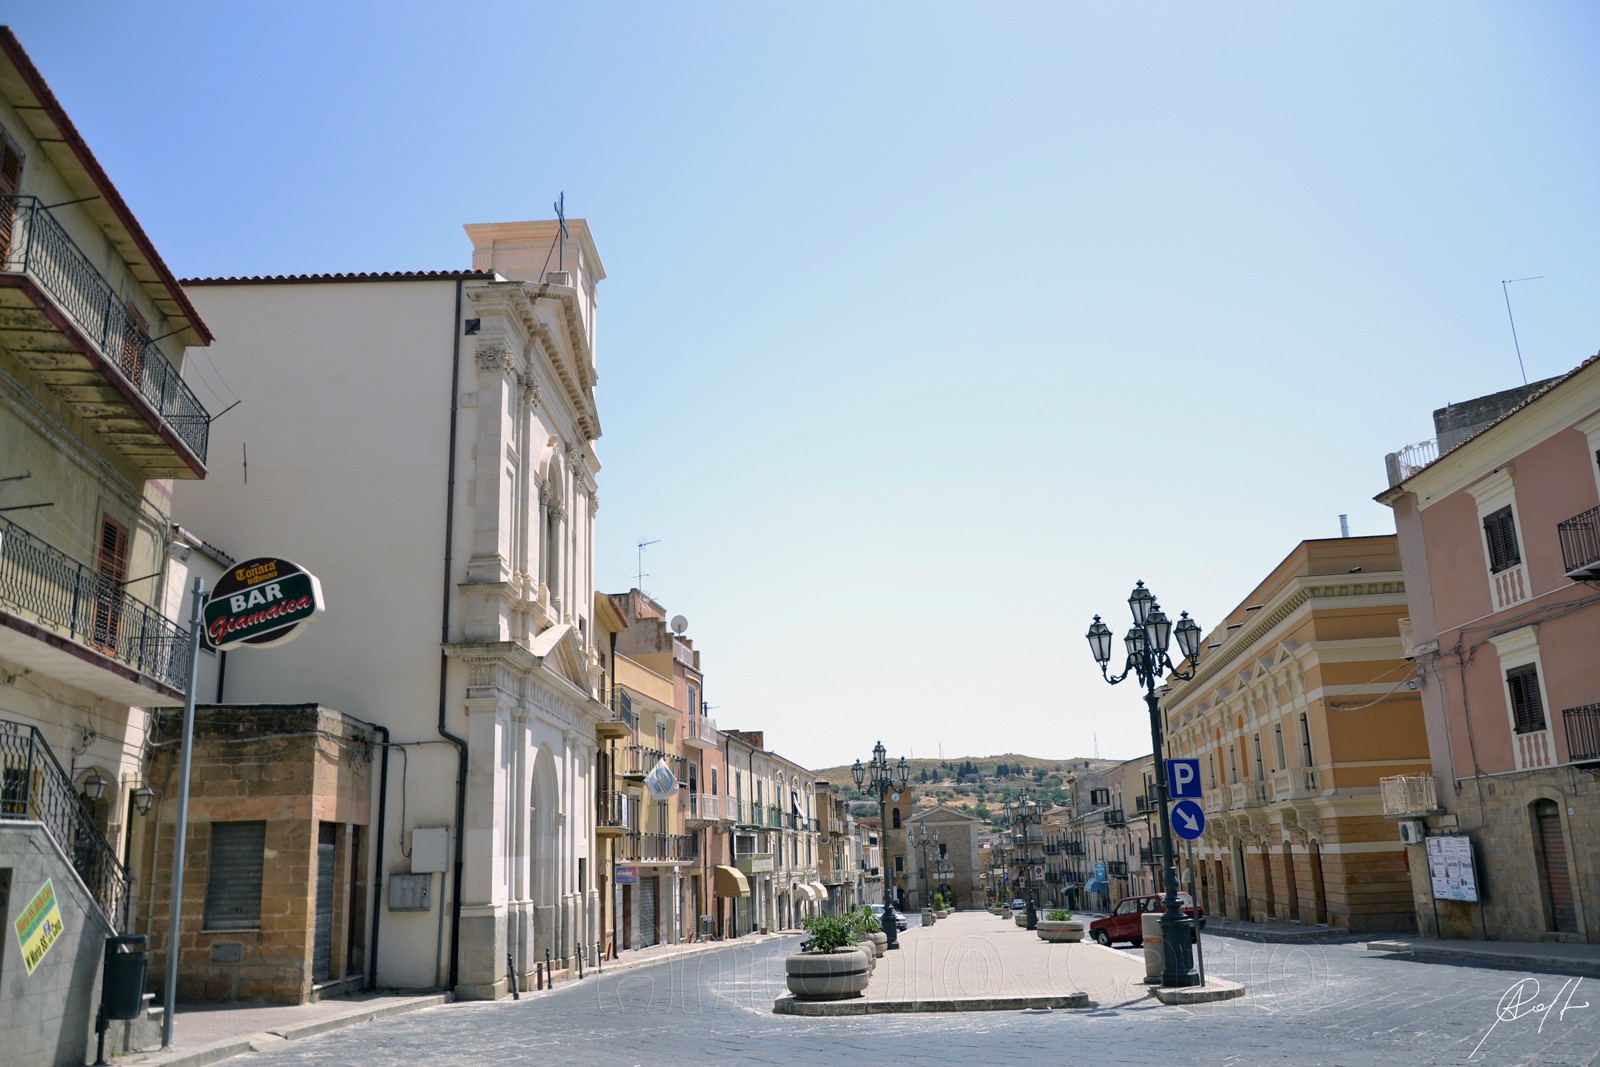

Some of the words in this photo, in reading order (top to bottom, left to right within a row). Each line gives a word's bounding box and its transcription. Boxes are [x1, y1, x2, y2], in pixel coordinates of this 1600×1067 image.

[235, 561, 276, 581] Tonaca
[230, 583, 284, 613] BAR
[209, 595, 312, 645] Giamaica
[1174, 763, 1194, 795] P
